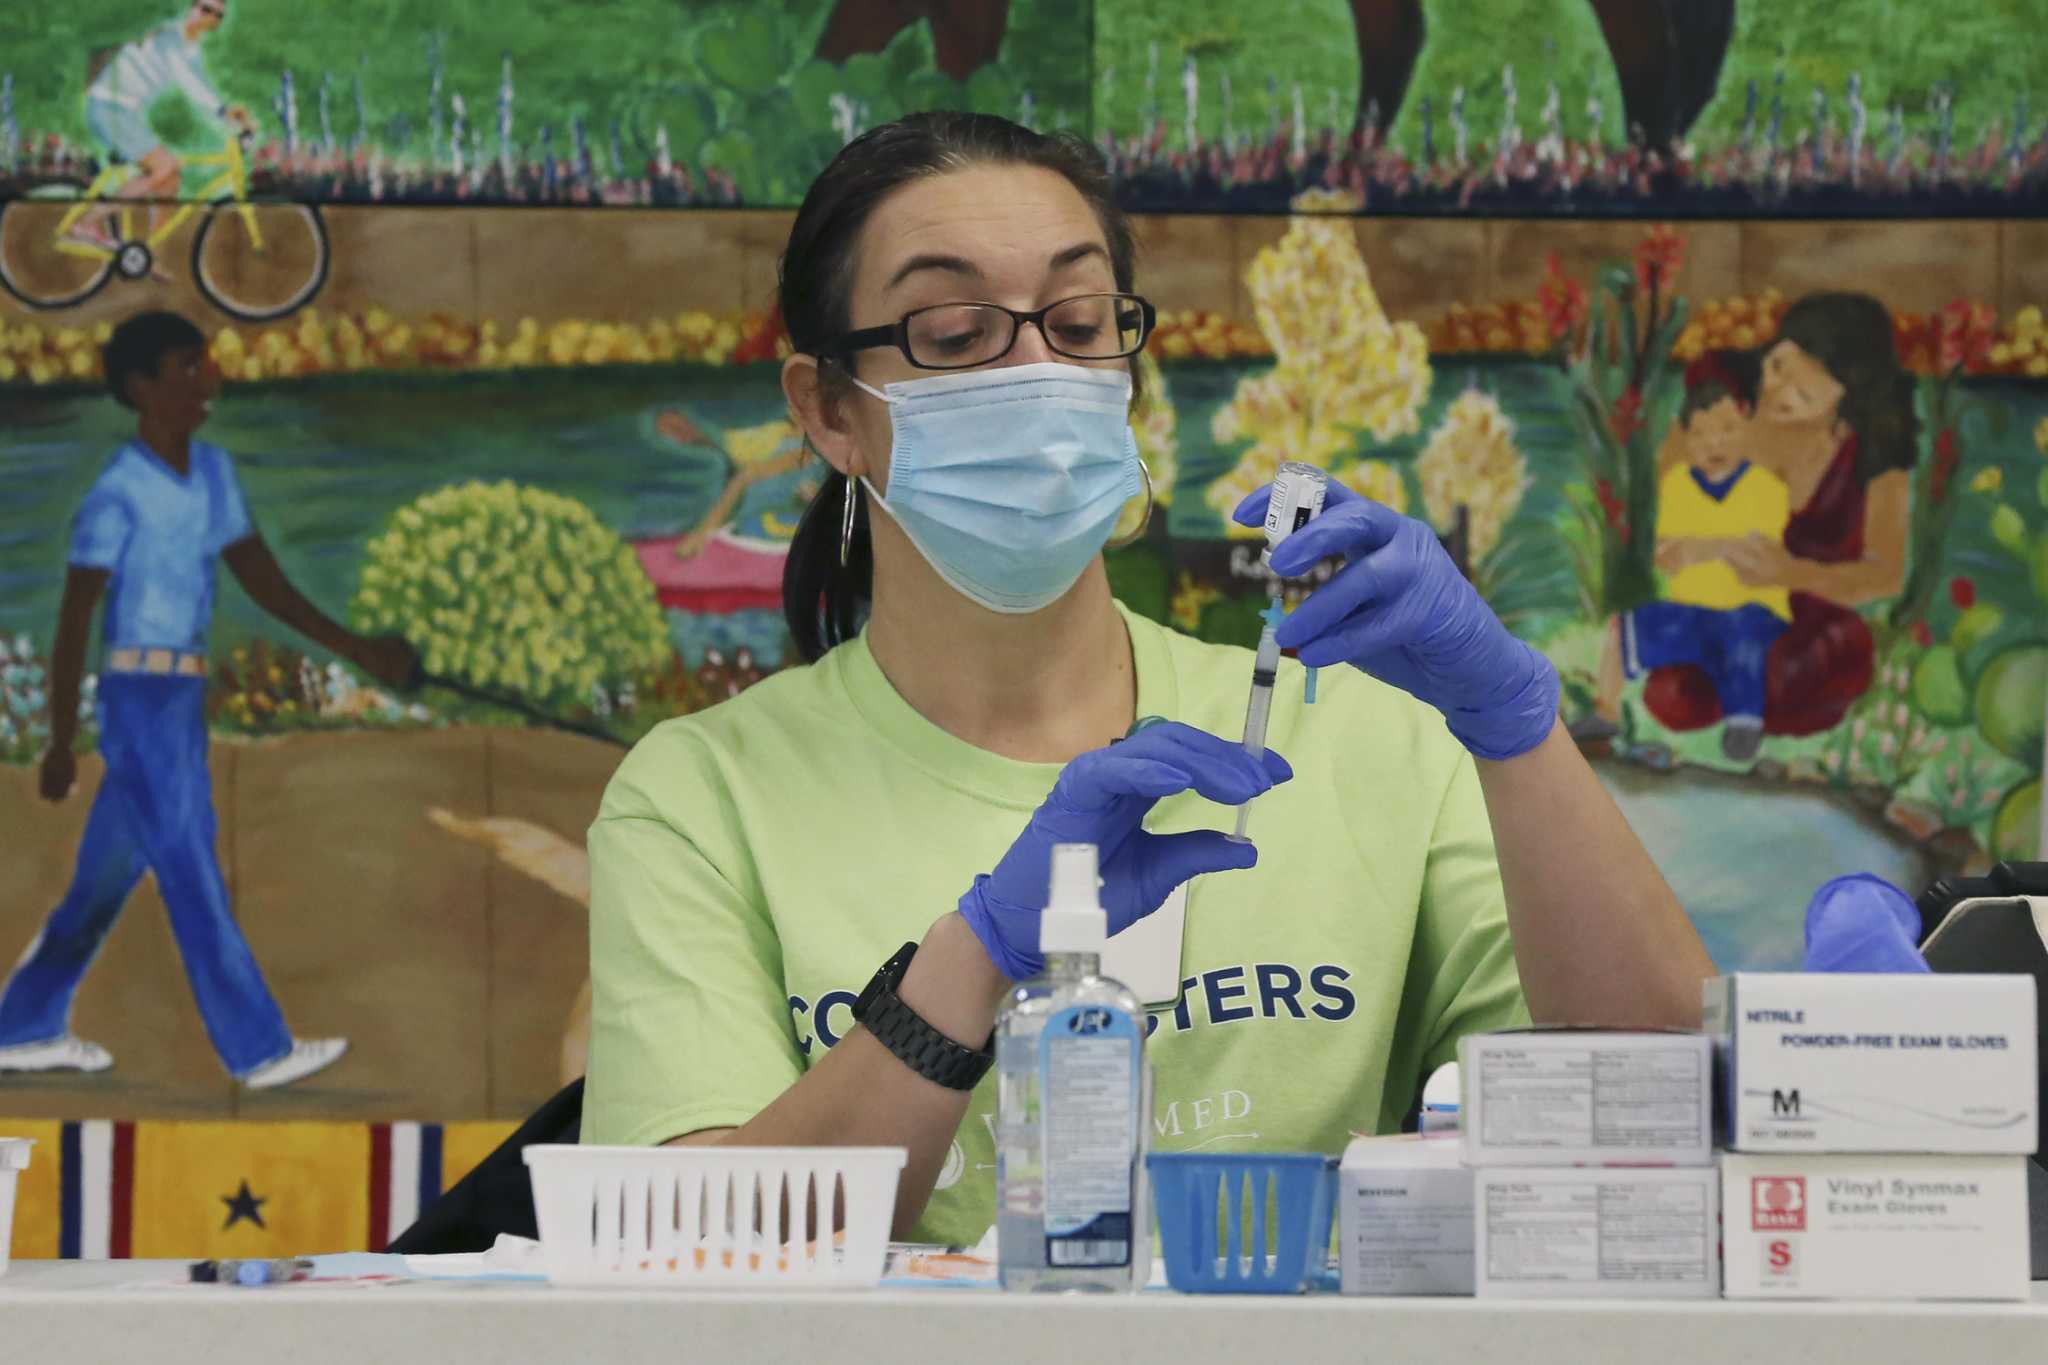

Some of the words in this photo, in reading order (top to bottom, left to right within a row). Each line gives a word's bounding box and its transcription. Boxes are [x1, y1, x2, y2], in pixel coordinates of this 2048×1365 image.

[1746, 1010, 1806, 1025] NITRILE
[1780, 1034, 1893, 1050] POWDER-FREE
[1898, 1035, 1944, 1050] EXAM
[1946, 1035, 2009, 1050] GLOVES
[1772, 1088, 1801, 1115] M
[1154, 1089, 1252, 1137] MED
[1826, 1178, 1883, 1199] Vinyl
[1890, 1178, 1980, 1199] Synmax
[1826, 1199, 1880, 1215] Exam
[1884, 1199, 1948, 1215] Gloves
[1768, 1240, 1793, 1268] S
